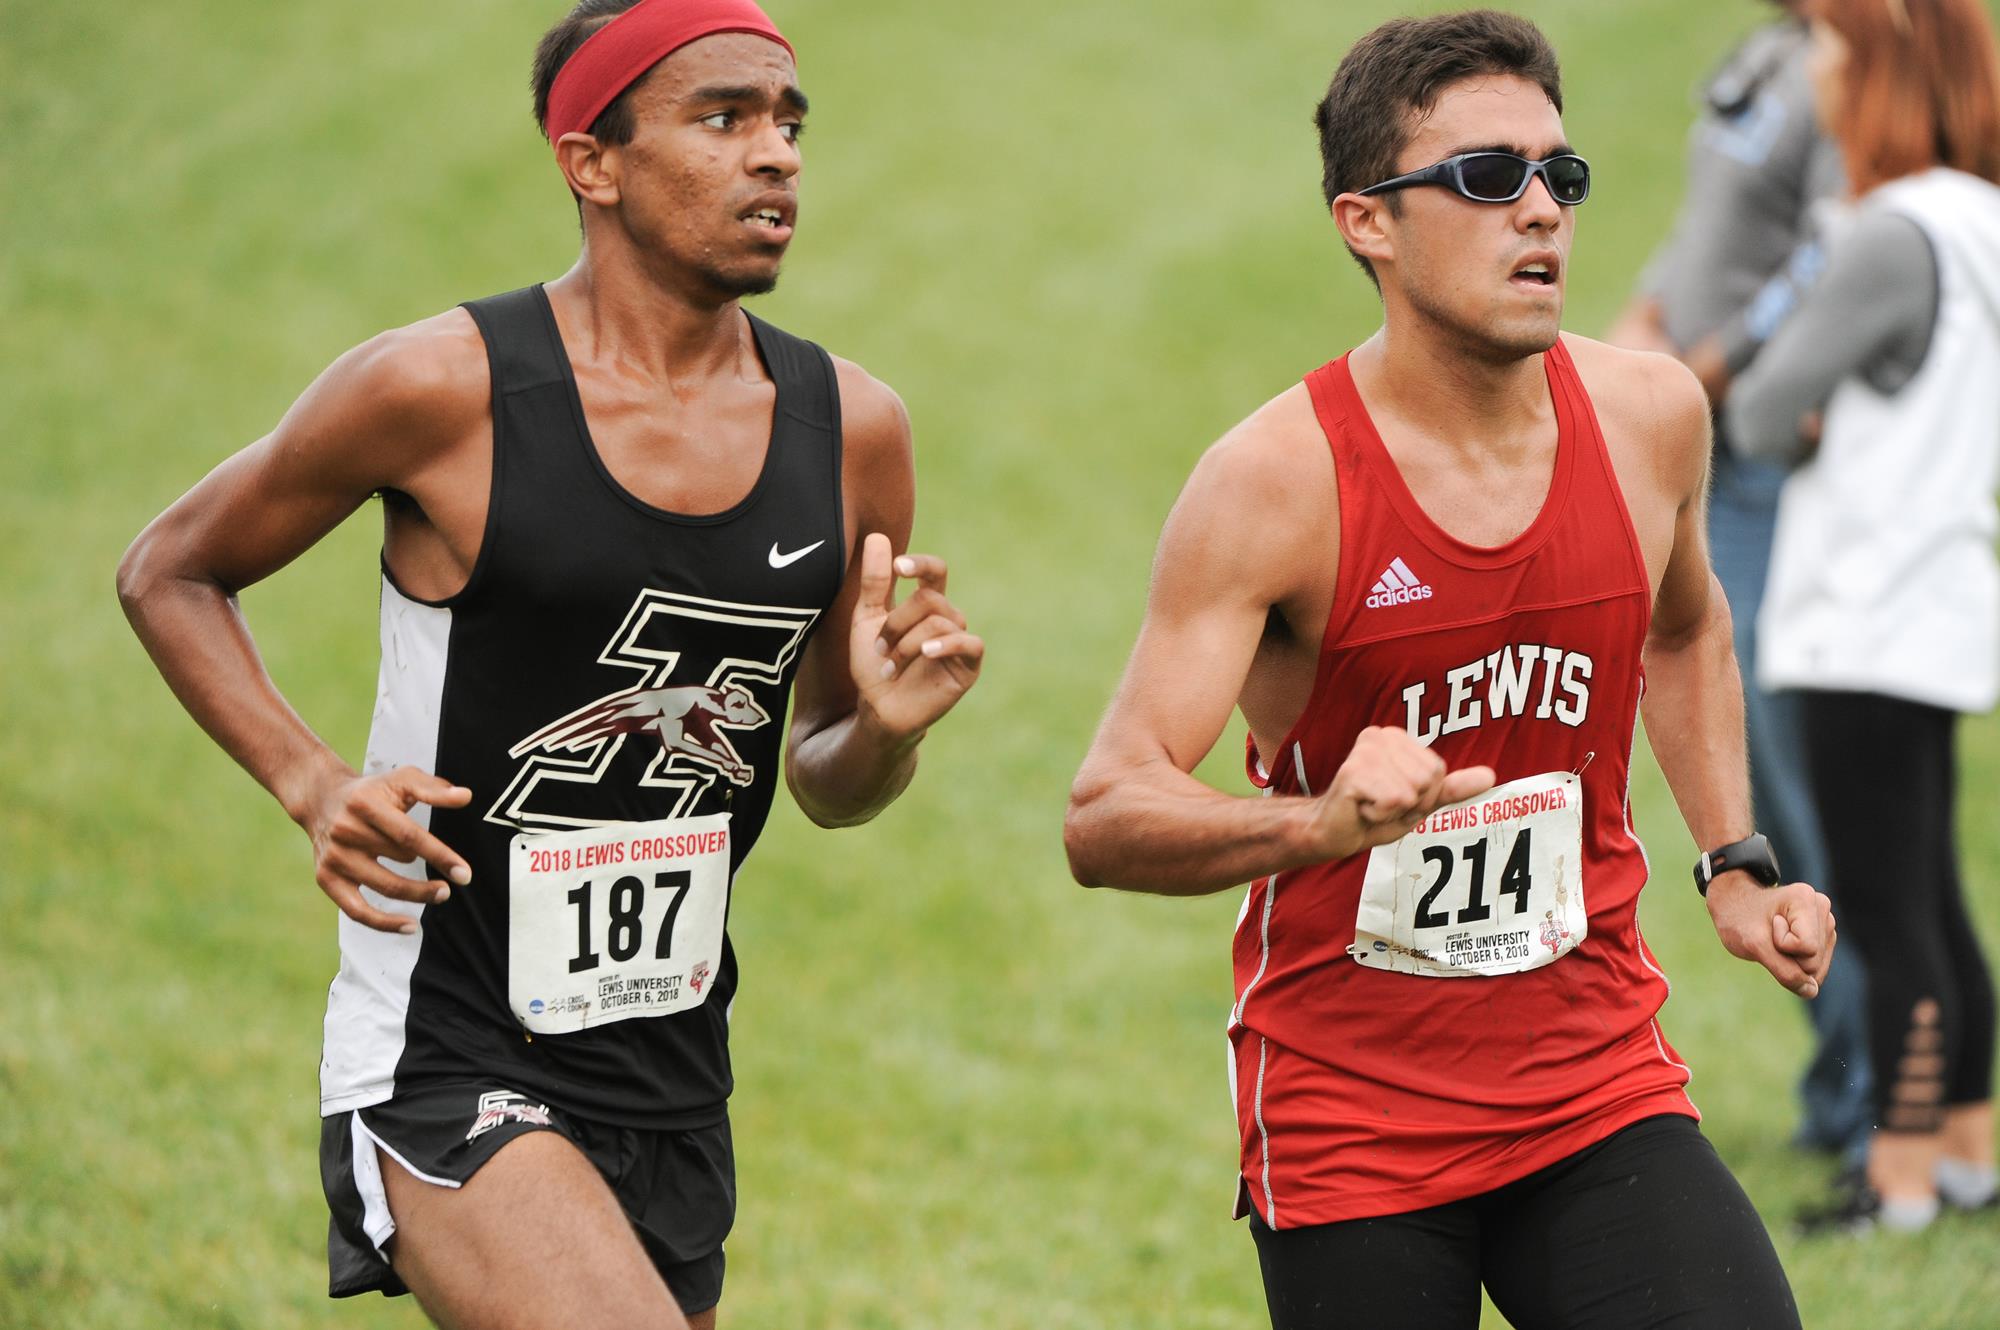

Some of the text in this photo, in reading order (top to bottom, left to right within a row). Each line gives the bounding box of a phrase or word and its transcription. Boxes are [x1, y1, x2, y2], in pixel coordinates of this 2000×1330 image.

[1365, 583, 1433, 609] adidas
[1402, 644, 1593, 750] LEWIS
[1431, 806, 1478, 833] LEWIS
[1483, 787, 1567, 825] CROSSOVER
[530, 831, 727, 873] 2018 LEWIS CROSSOVER
[1414, 827, 1532, 929] 214
[567, 870, 692, 974] 187
[1445, 930, 1530, 954] LEWIS UNIVERSITY
[1450, 950, 1492, 967] OCTOBER
[1494, 949, 1504, 962] 6,
[1506, 945, 1529, 959] 2018
[598, 980, 624, 997] LEWIS
[626, 975, 684, 992] UNIVERSITY
[601, 988, 679, 1010] OCTOBER 6, 2018
